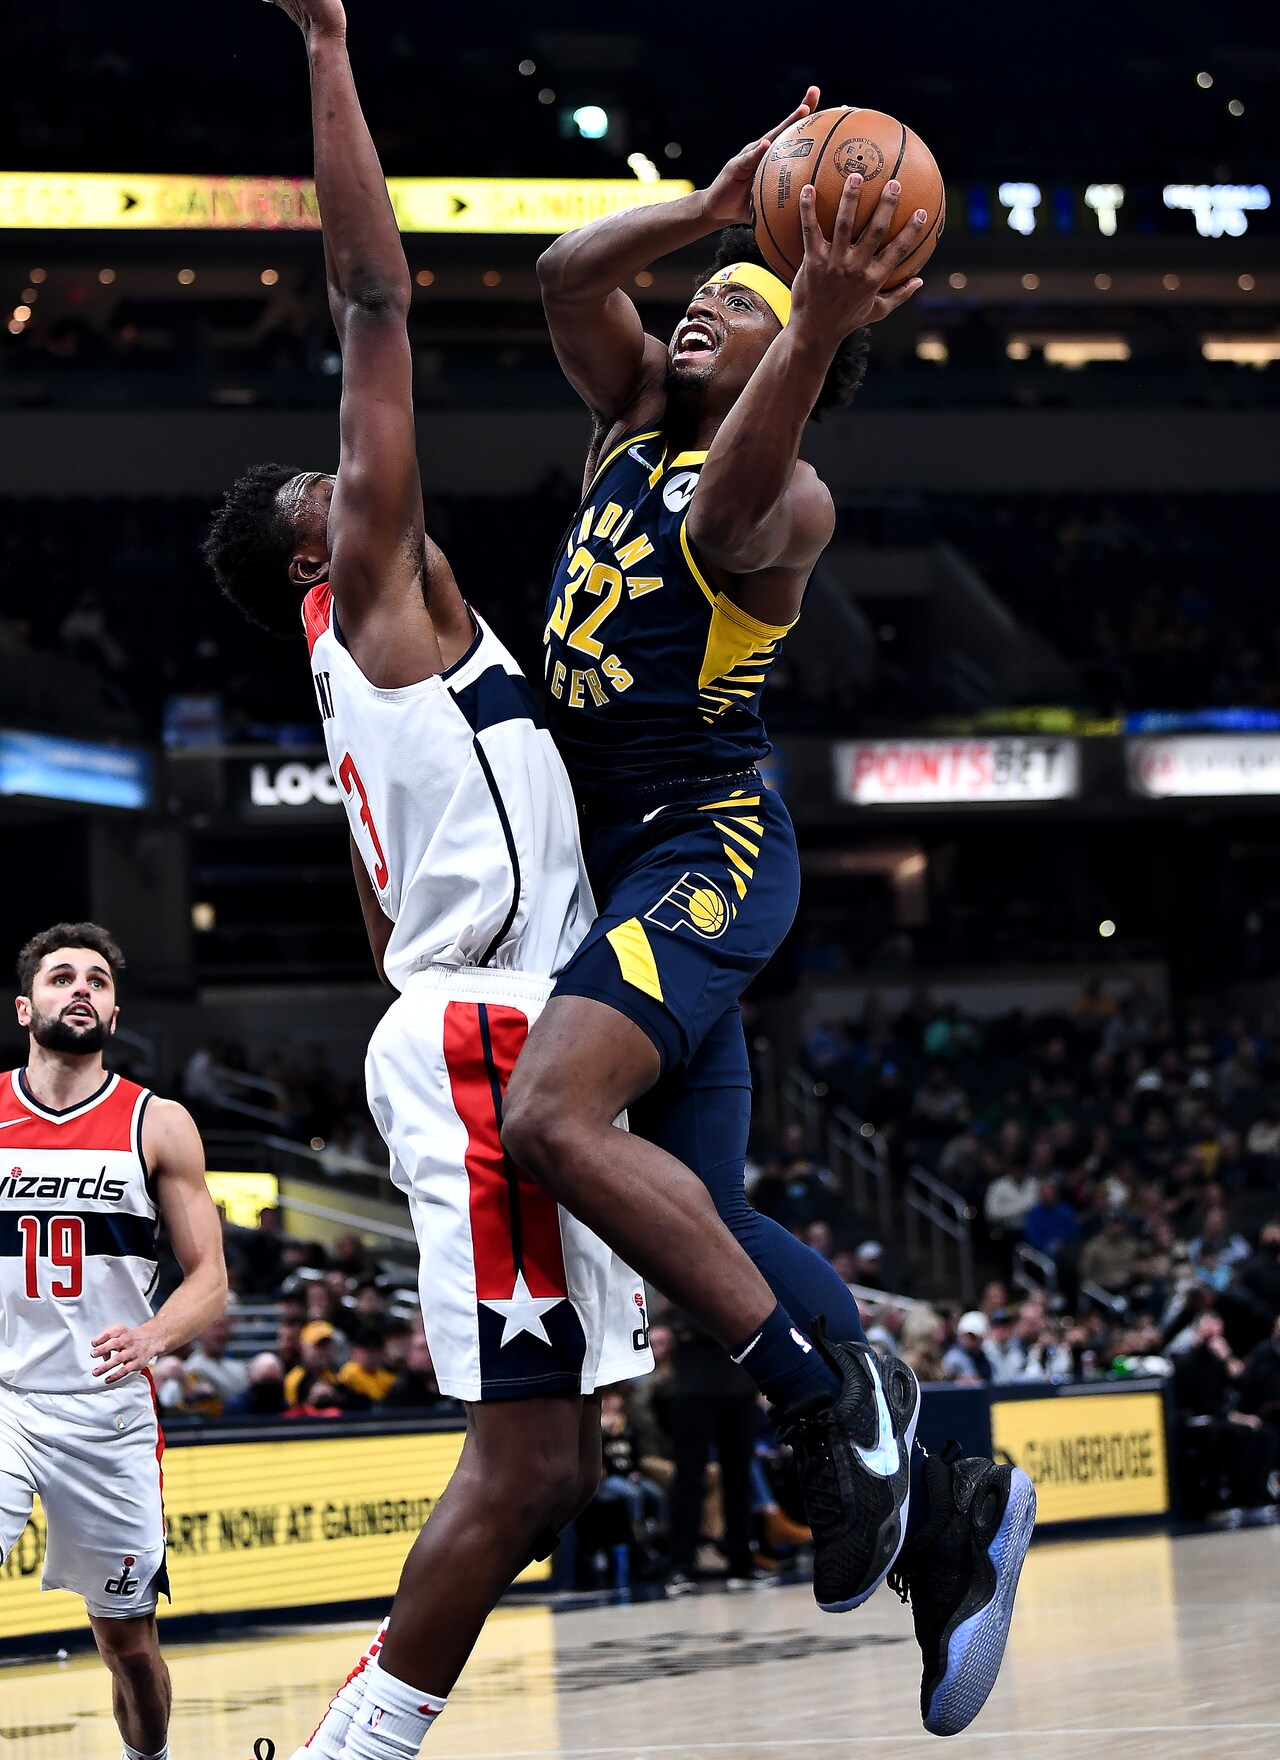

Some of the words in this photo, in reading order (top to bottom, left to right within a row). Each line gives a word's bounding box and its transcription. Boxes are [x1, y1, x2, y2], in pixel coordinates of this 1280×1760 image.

[567, 502, 664, 600] INDANA
[550, 546, 623, 660] 32
[543, 622, 634, 708] CERS
[853, 745, 1060, 788] POINTSBET
[339, 752, 389, 890] 3
[18, 1216, 85, 1300] 19
[219, 1507, 279, 1550] NOW
[284, 1502, 313, 1545] AT
[104, 1562, 140, 1596] dc
